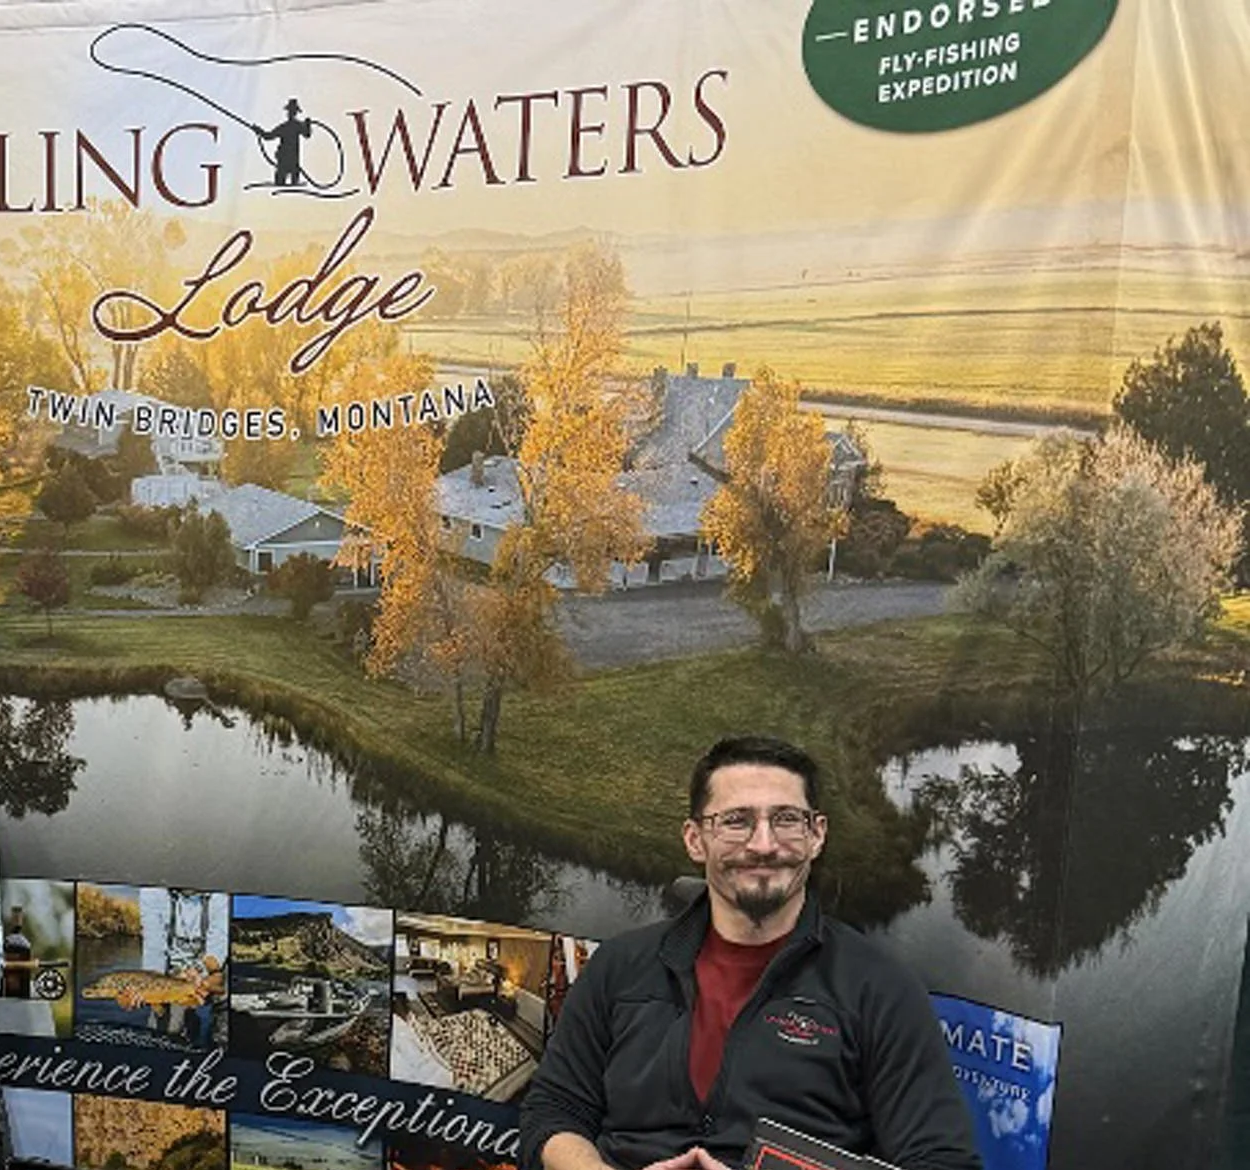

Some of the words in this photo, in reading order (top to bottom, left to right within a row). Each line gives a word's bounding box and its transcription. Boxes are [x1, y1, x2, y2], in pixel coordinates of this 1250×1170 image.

[853, 0, 1051, 44] ENDORSE
[877, 61, 1019, 103] EXPEDITION
[879, 32, 1021, 76] FLY-FISHING
[350, 69, 731, 195] WATERS
[92, 206, 436, 375] Lodge
[26, 385, 116, 429] TWIN
[317, 379, 495, 436] MONTANA
[937, 1018, 1031, 1073] MATE
[164, 1046, 237, 1104] the
[260, 1051, 521, 1160] Exceptiona
